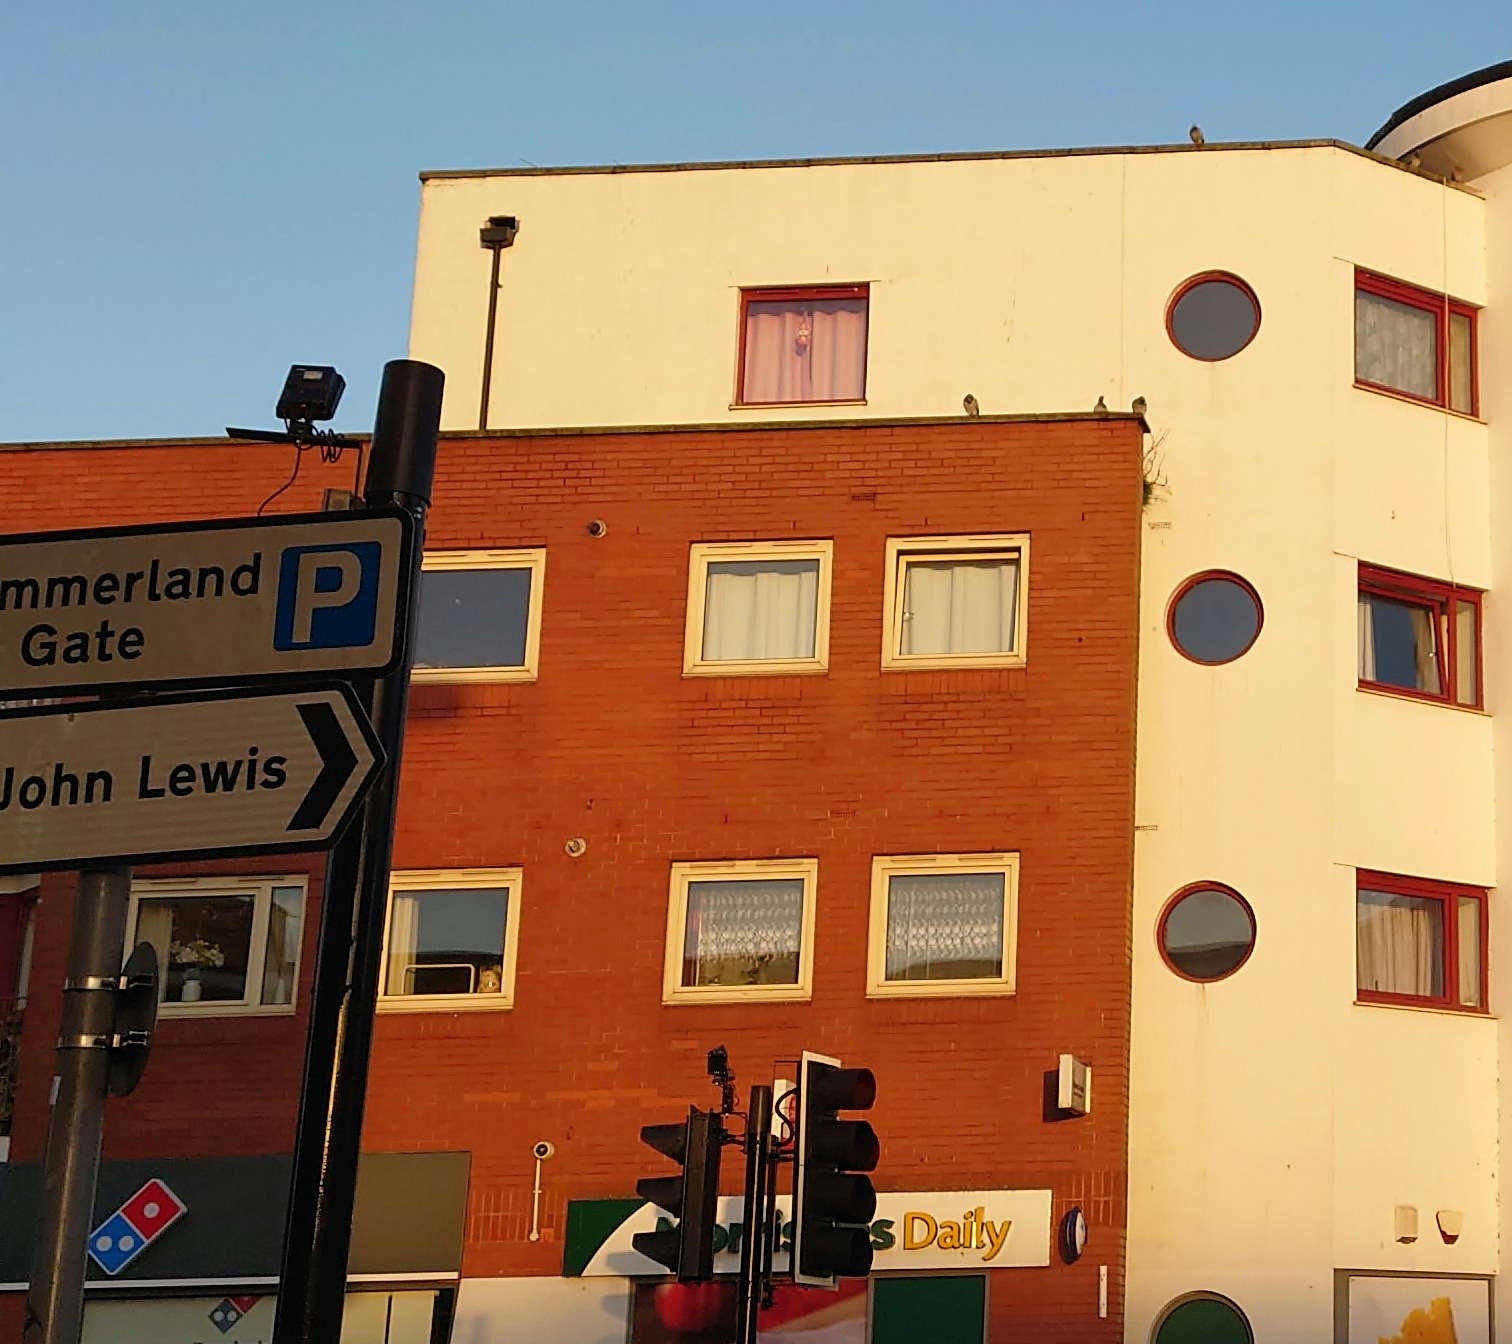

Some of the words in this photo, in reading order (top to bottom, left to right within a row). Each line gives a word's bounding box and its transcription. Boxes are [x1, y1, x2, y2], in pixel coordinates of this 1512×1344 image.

[291, 550, 362, 644] P
[21, 620, 146, 667] Gate
[0, 762, 112, 811] John
[138, 746, 288, 799] Lewis
[904, 1206, 1012, 1262] Daily
